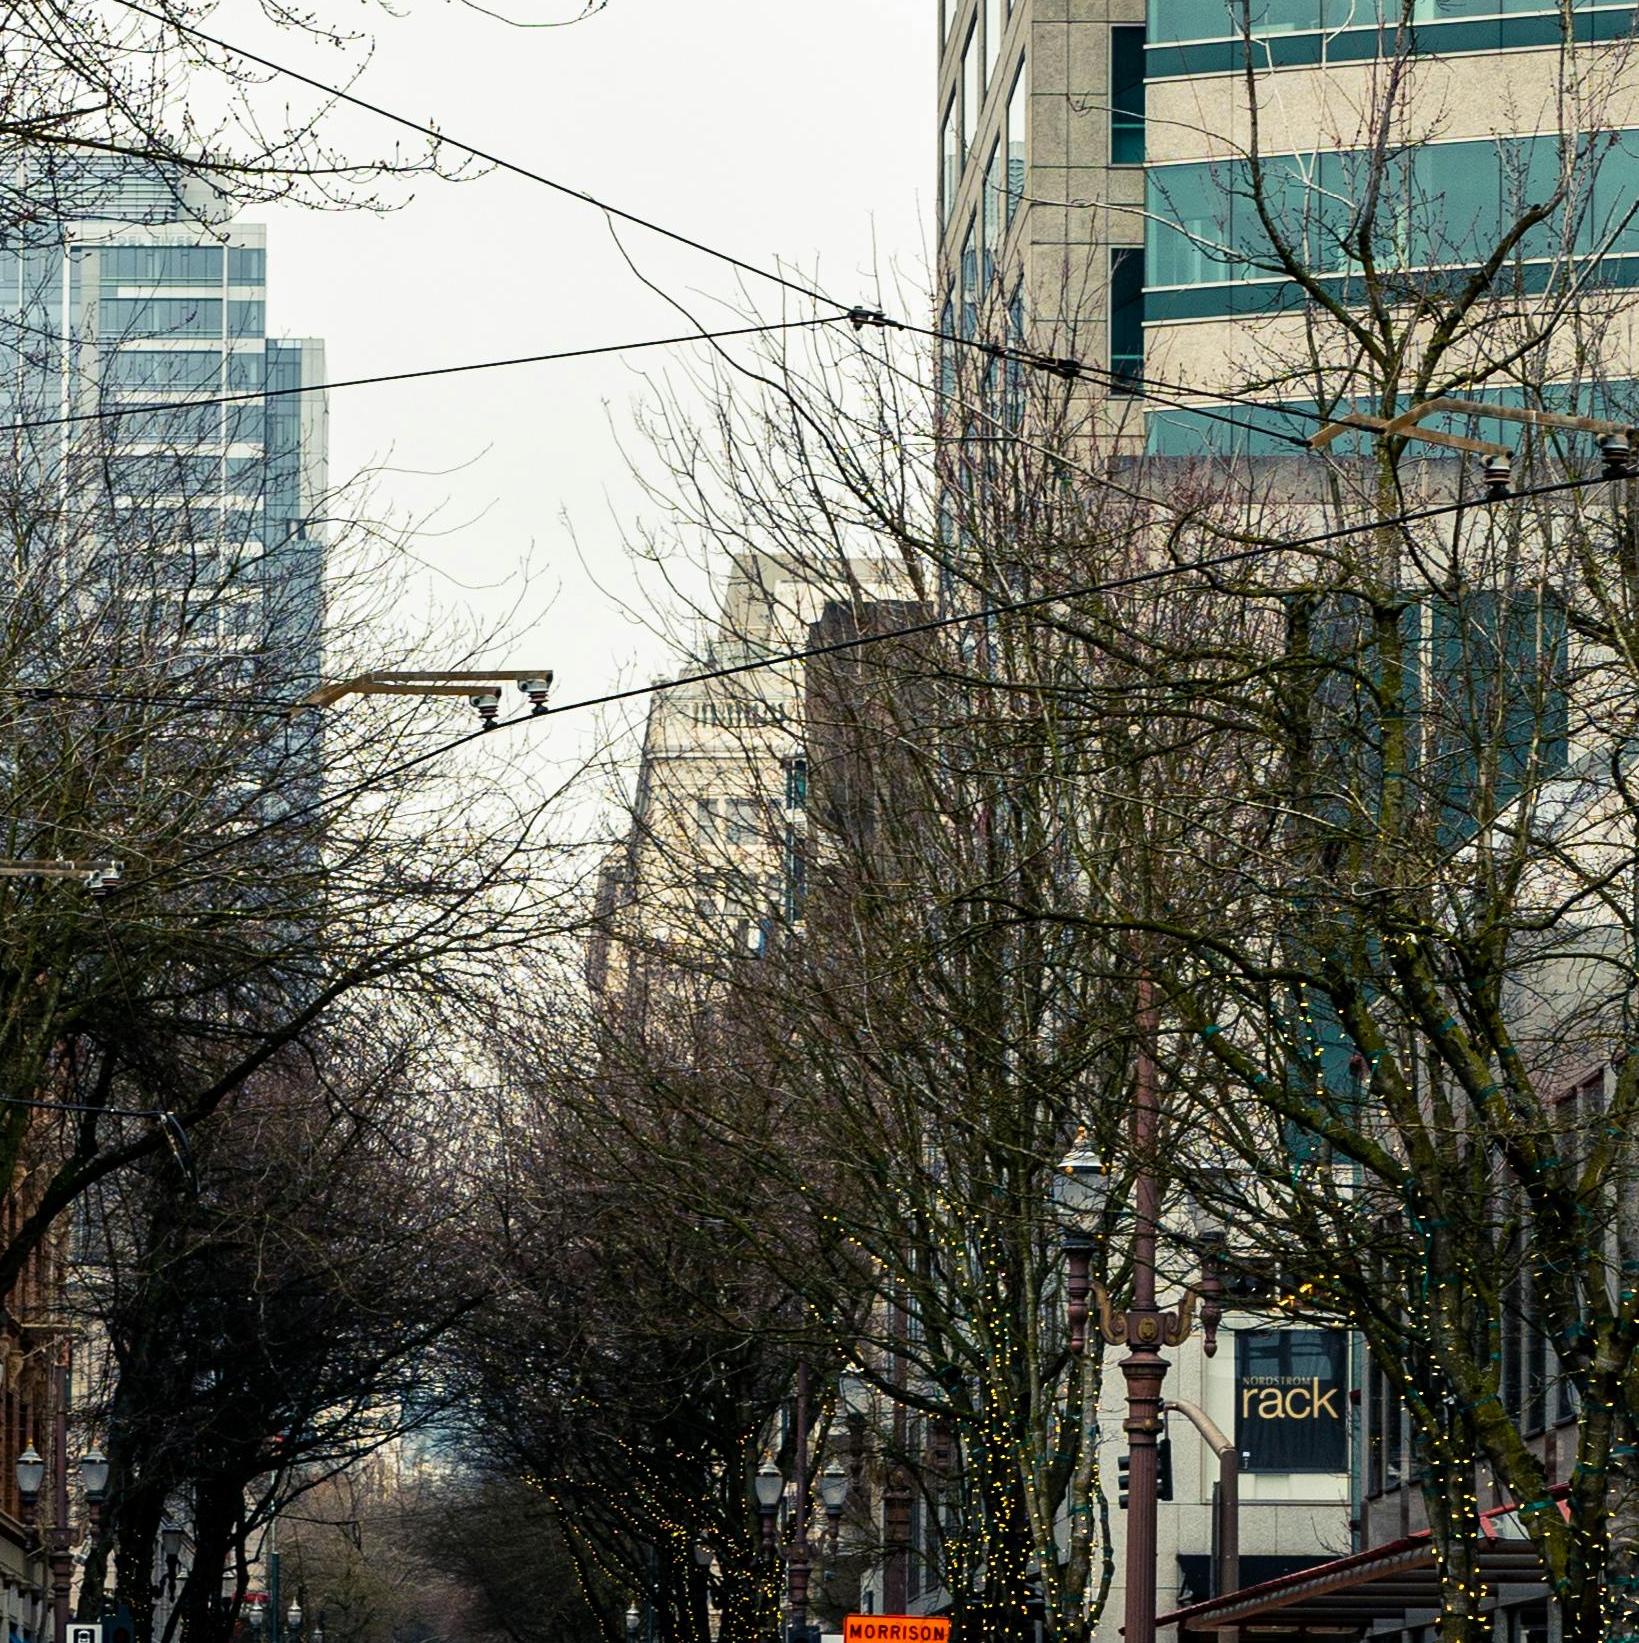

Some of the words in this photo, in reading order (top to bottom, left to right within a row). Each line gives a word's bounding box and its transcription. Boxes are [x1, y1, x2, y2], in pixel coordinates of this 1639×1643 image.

[1242, 1376, 1311, 1386] NORDSTROM
[1242, 1376, 1339, 1419] rack
[849, 1624, 945, 1641] MORRISON
